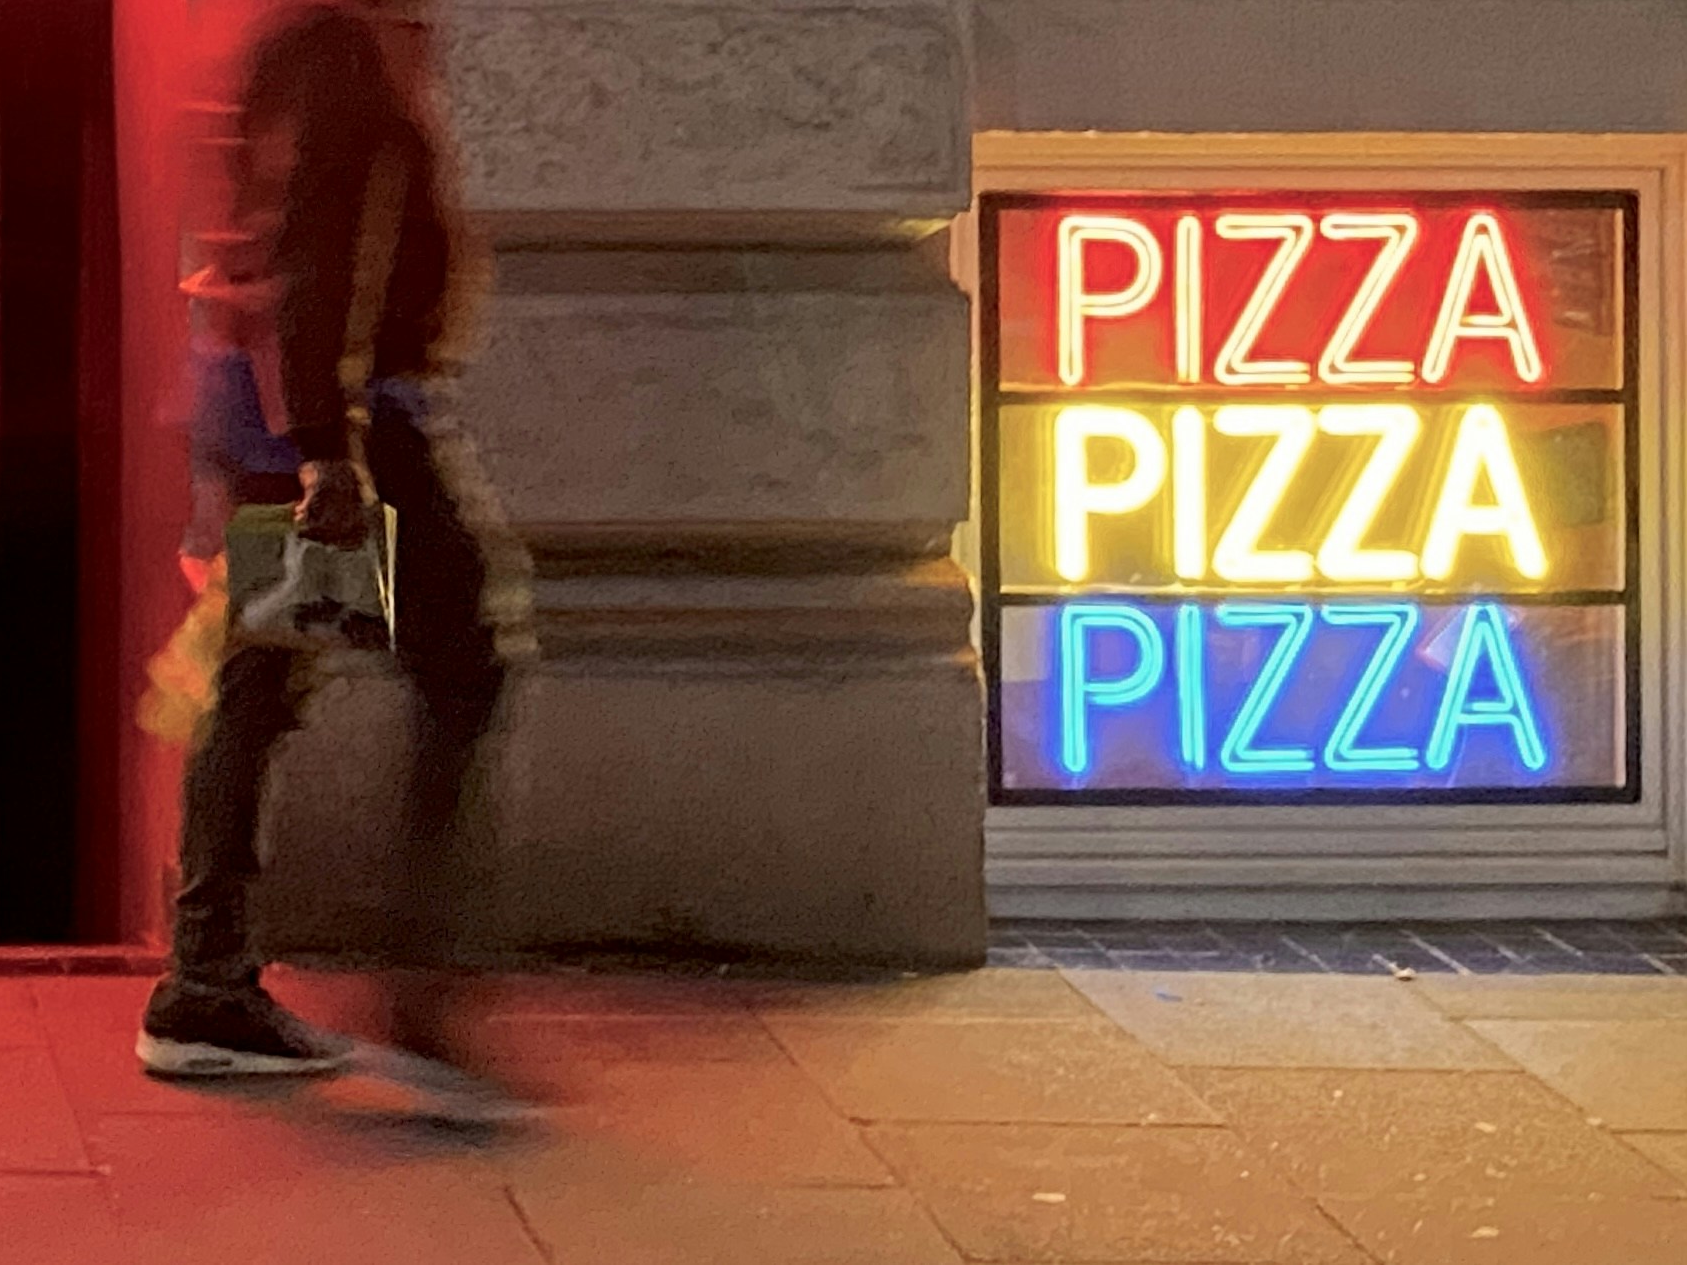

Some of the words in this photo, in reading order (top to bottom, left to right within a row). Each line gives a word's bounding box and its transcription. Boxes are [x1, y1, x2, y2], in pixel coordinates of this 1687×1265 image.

[1056, 212, 1545, 387] PIZZA
[1051, 402, 1550, 584] PIZZA
[1058, 602, 1548, 773] PIZZA
